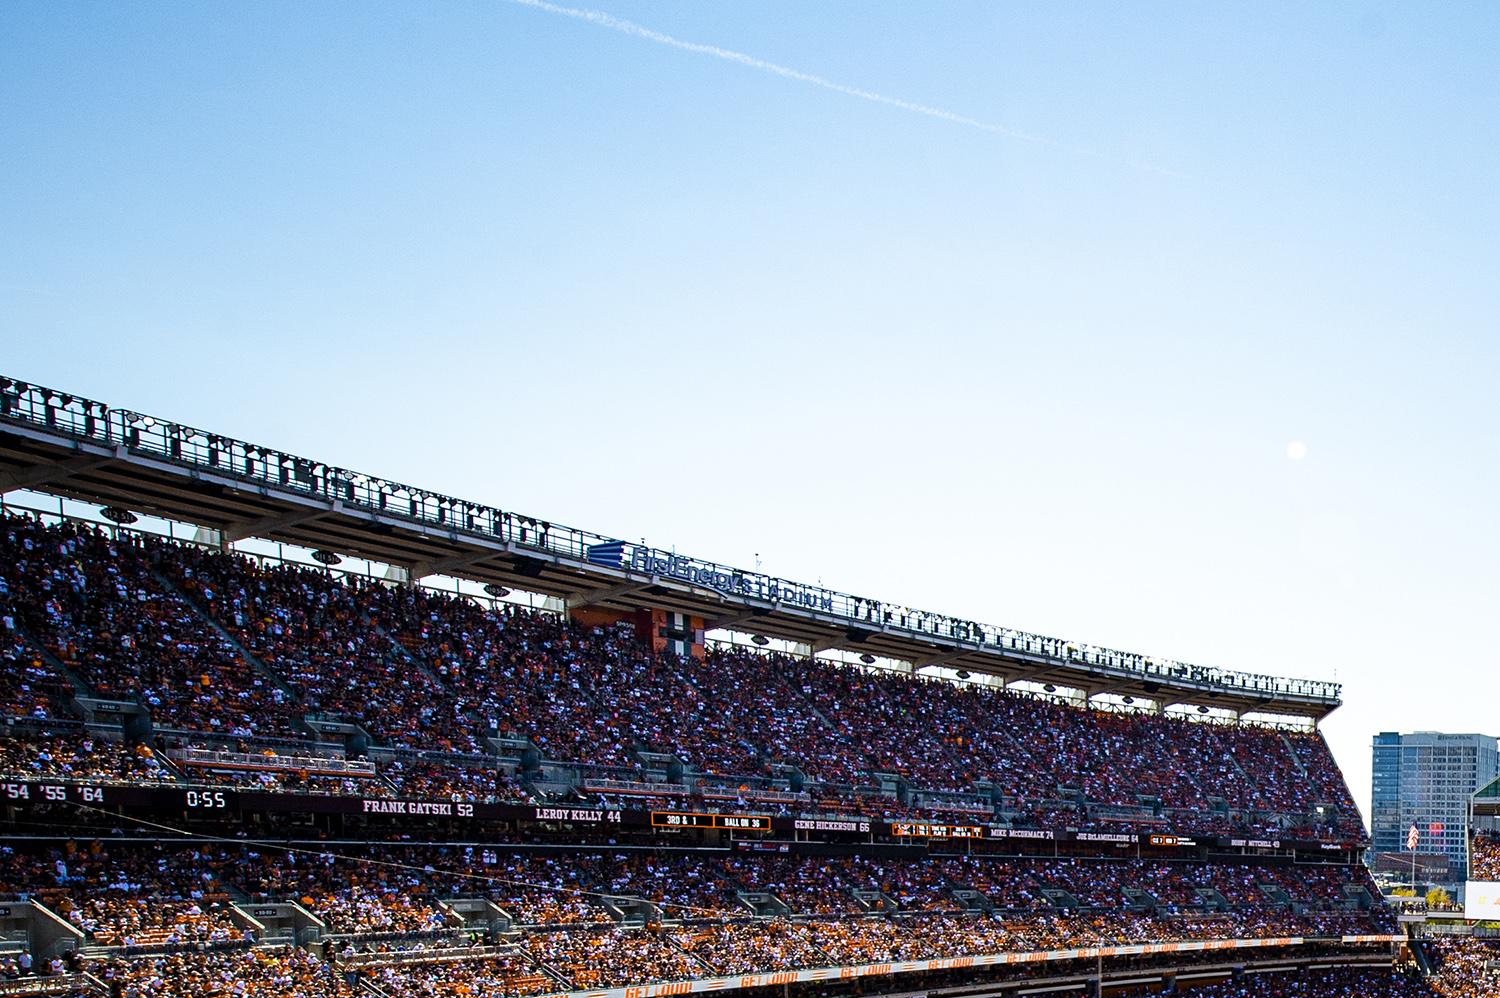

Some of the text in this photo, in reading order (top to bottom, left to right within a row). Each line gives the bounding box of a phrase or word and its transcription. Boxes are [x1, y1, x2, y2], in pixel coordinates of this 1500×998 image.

[632, 547, 833, 610] FirstEnergy STADIUM
[39, 785, 66, 800] '55
[77, 787, 103, 801] '64
[187, 791, 225, 807] 0:55
[363, 800, 473, 816] FRANK GATSKI 52
[536, 808, 621, 822] LEROY KELLY 44
[667, 815, 680, 824] 3RD
[725, 818, 739, 826] BALL
[795, 820, 869, 832] GENE HICKERSON 66
[841, 967, 861, 977] GET
[928, 960, 946, 970] GET
[741, 973, 798, 988] GET LOUD!
[653, 982, 694, 997] LOUD!
